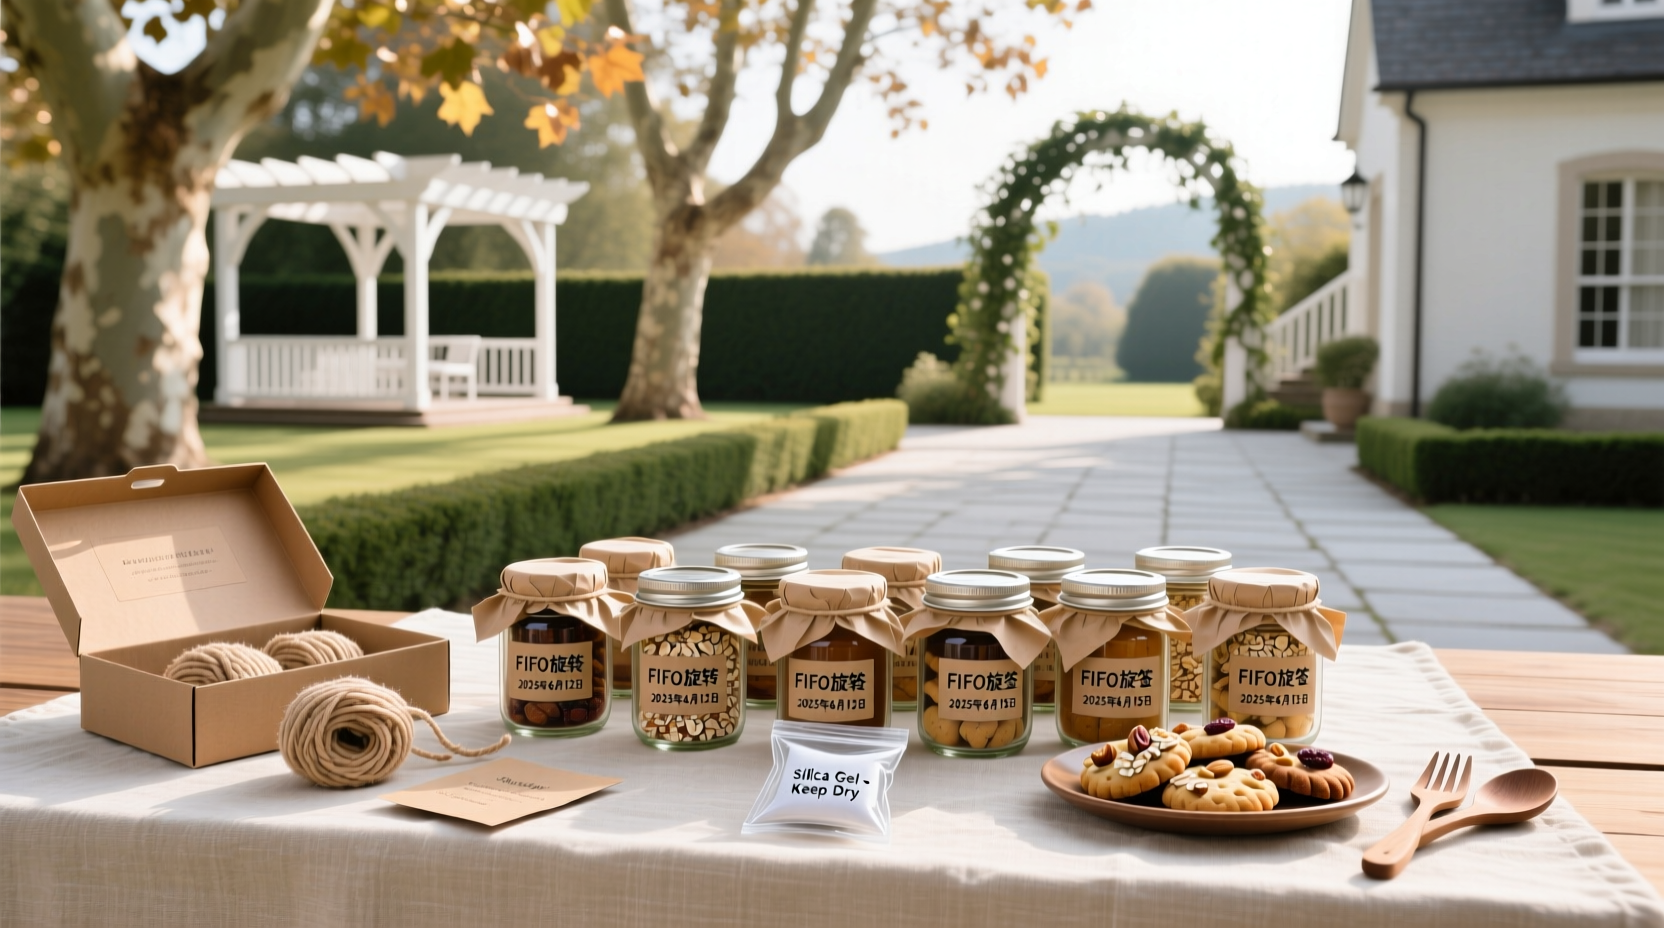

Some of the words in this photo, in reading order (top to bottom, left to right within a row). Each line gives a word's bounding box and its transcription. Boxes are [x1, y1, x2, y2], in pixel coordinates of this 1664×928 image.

[835, 771, 860, 785] Gel
[791, 783, 827, 799] Keep
[833, 785, 860, 801] Dry
